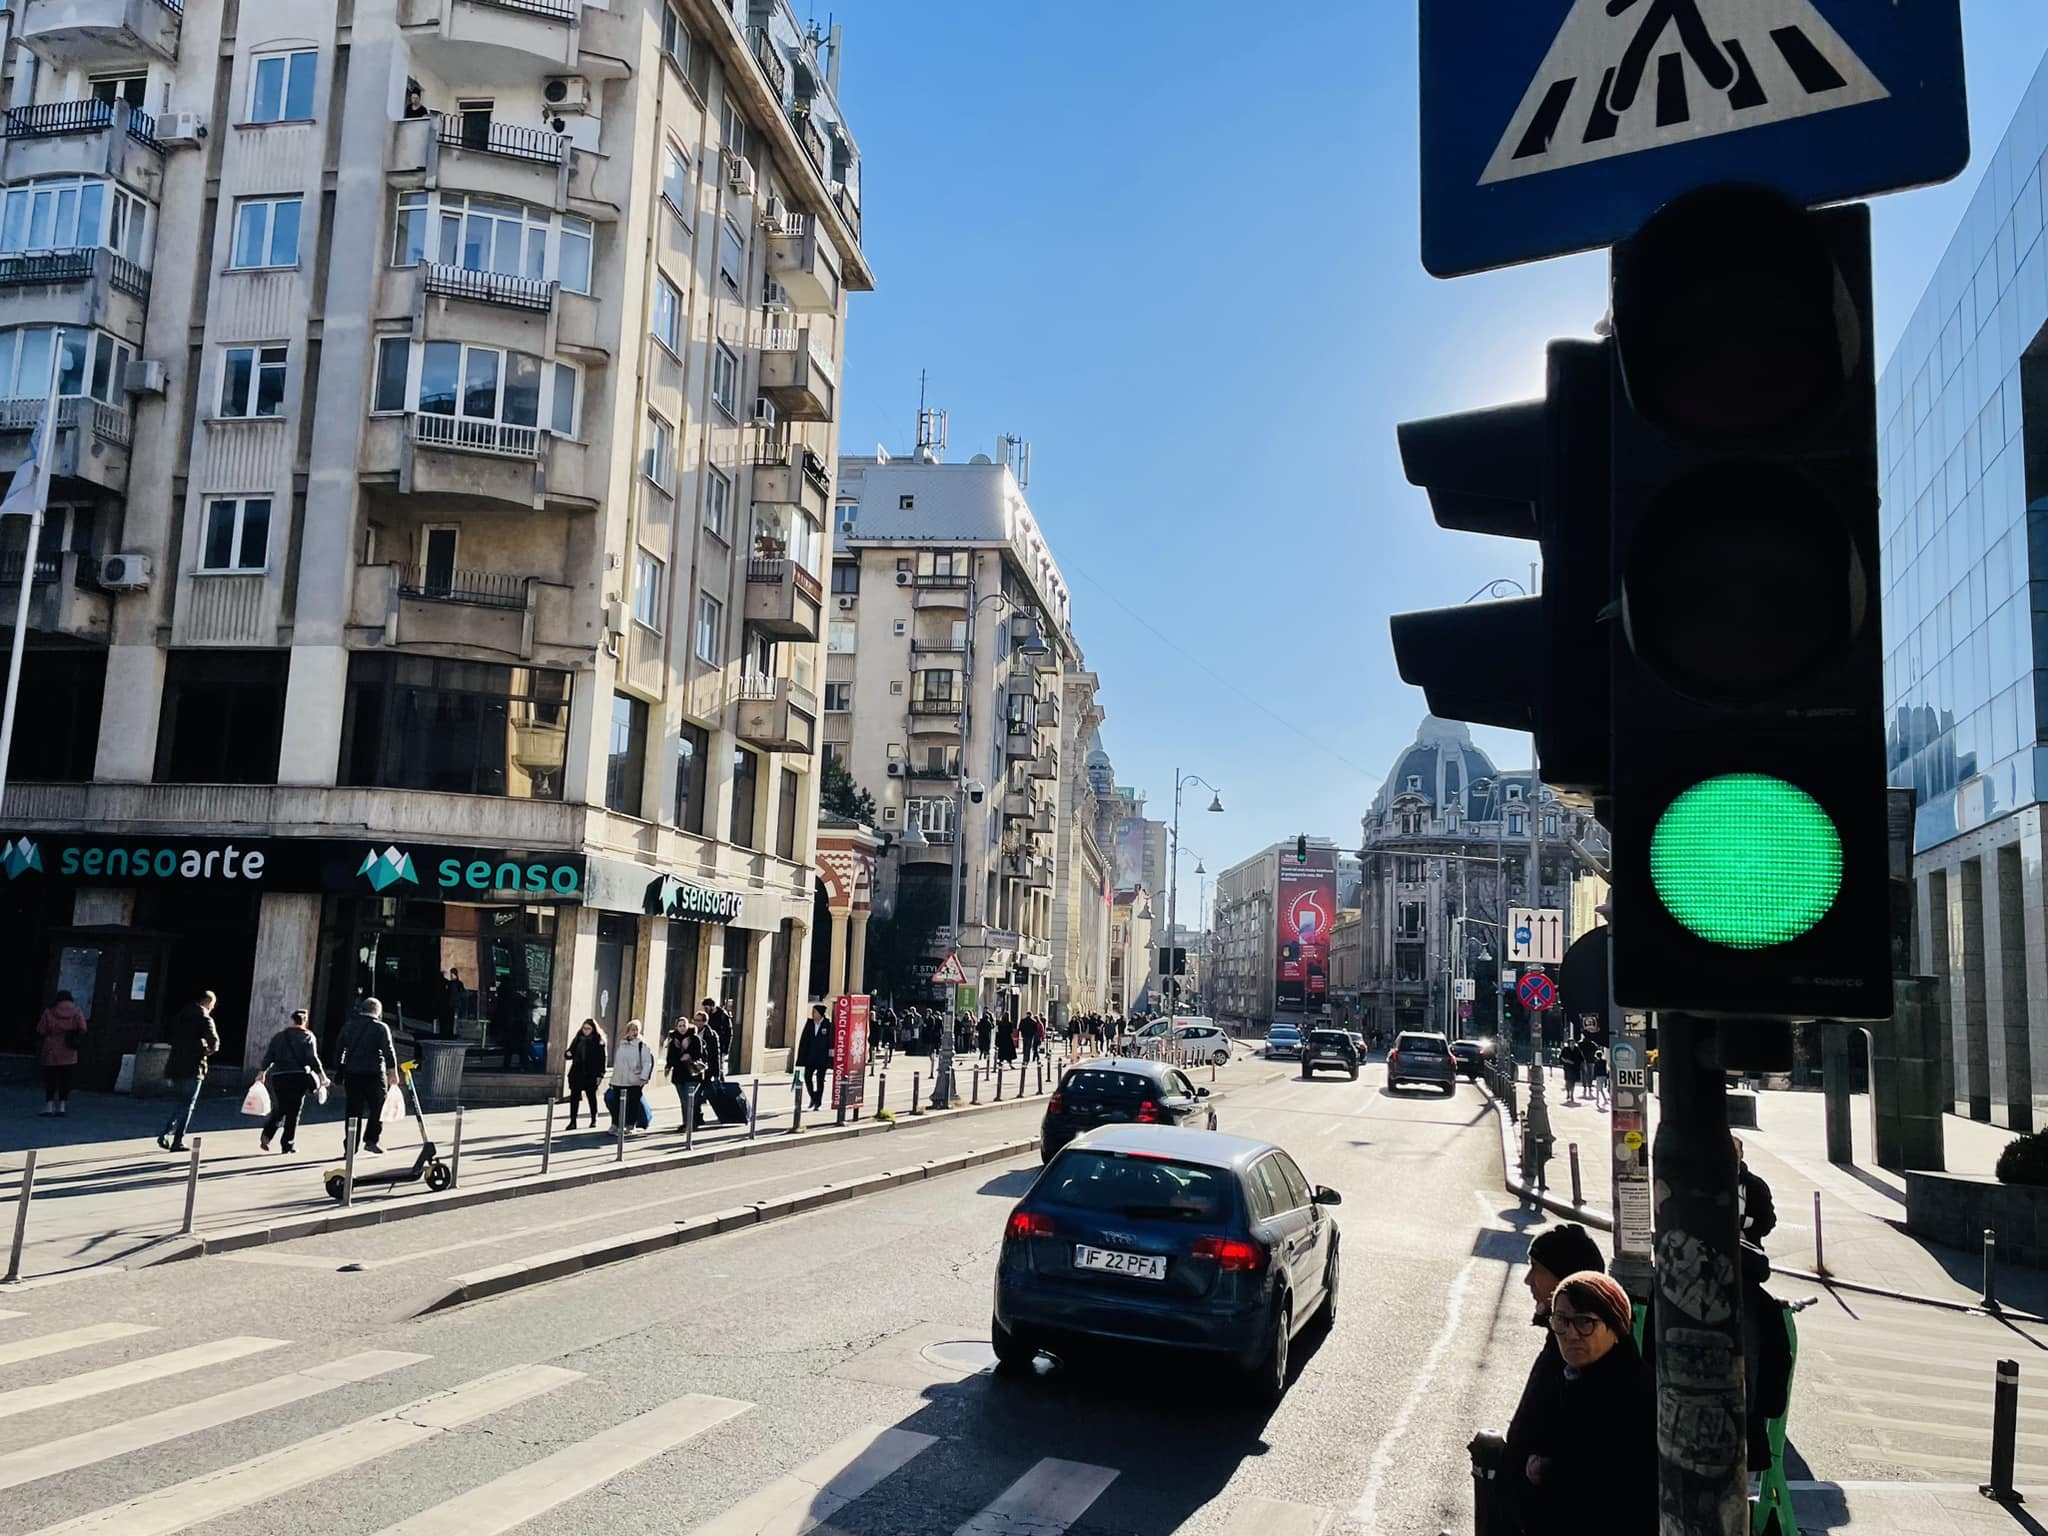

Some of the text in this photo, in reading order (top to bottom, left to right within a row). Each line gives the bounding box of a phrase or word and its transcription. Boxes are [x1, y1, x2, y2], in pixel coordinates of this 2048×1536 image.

[61, 845, 265, 879] sensoarte
[437, 858, 578, 894] senso
[682, 886, 743, 917] sensoarte
[839, 1010, 847, 1027] AICI
[837, 1030, 846, 1061] Cartela
[1619, 1070, 1643, 1086] BNE
[1086, 1250, 1157, 1274] IF 22 PFA
